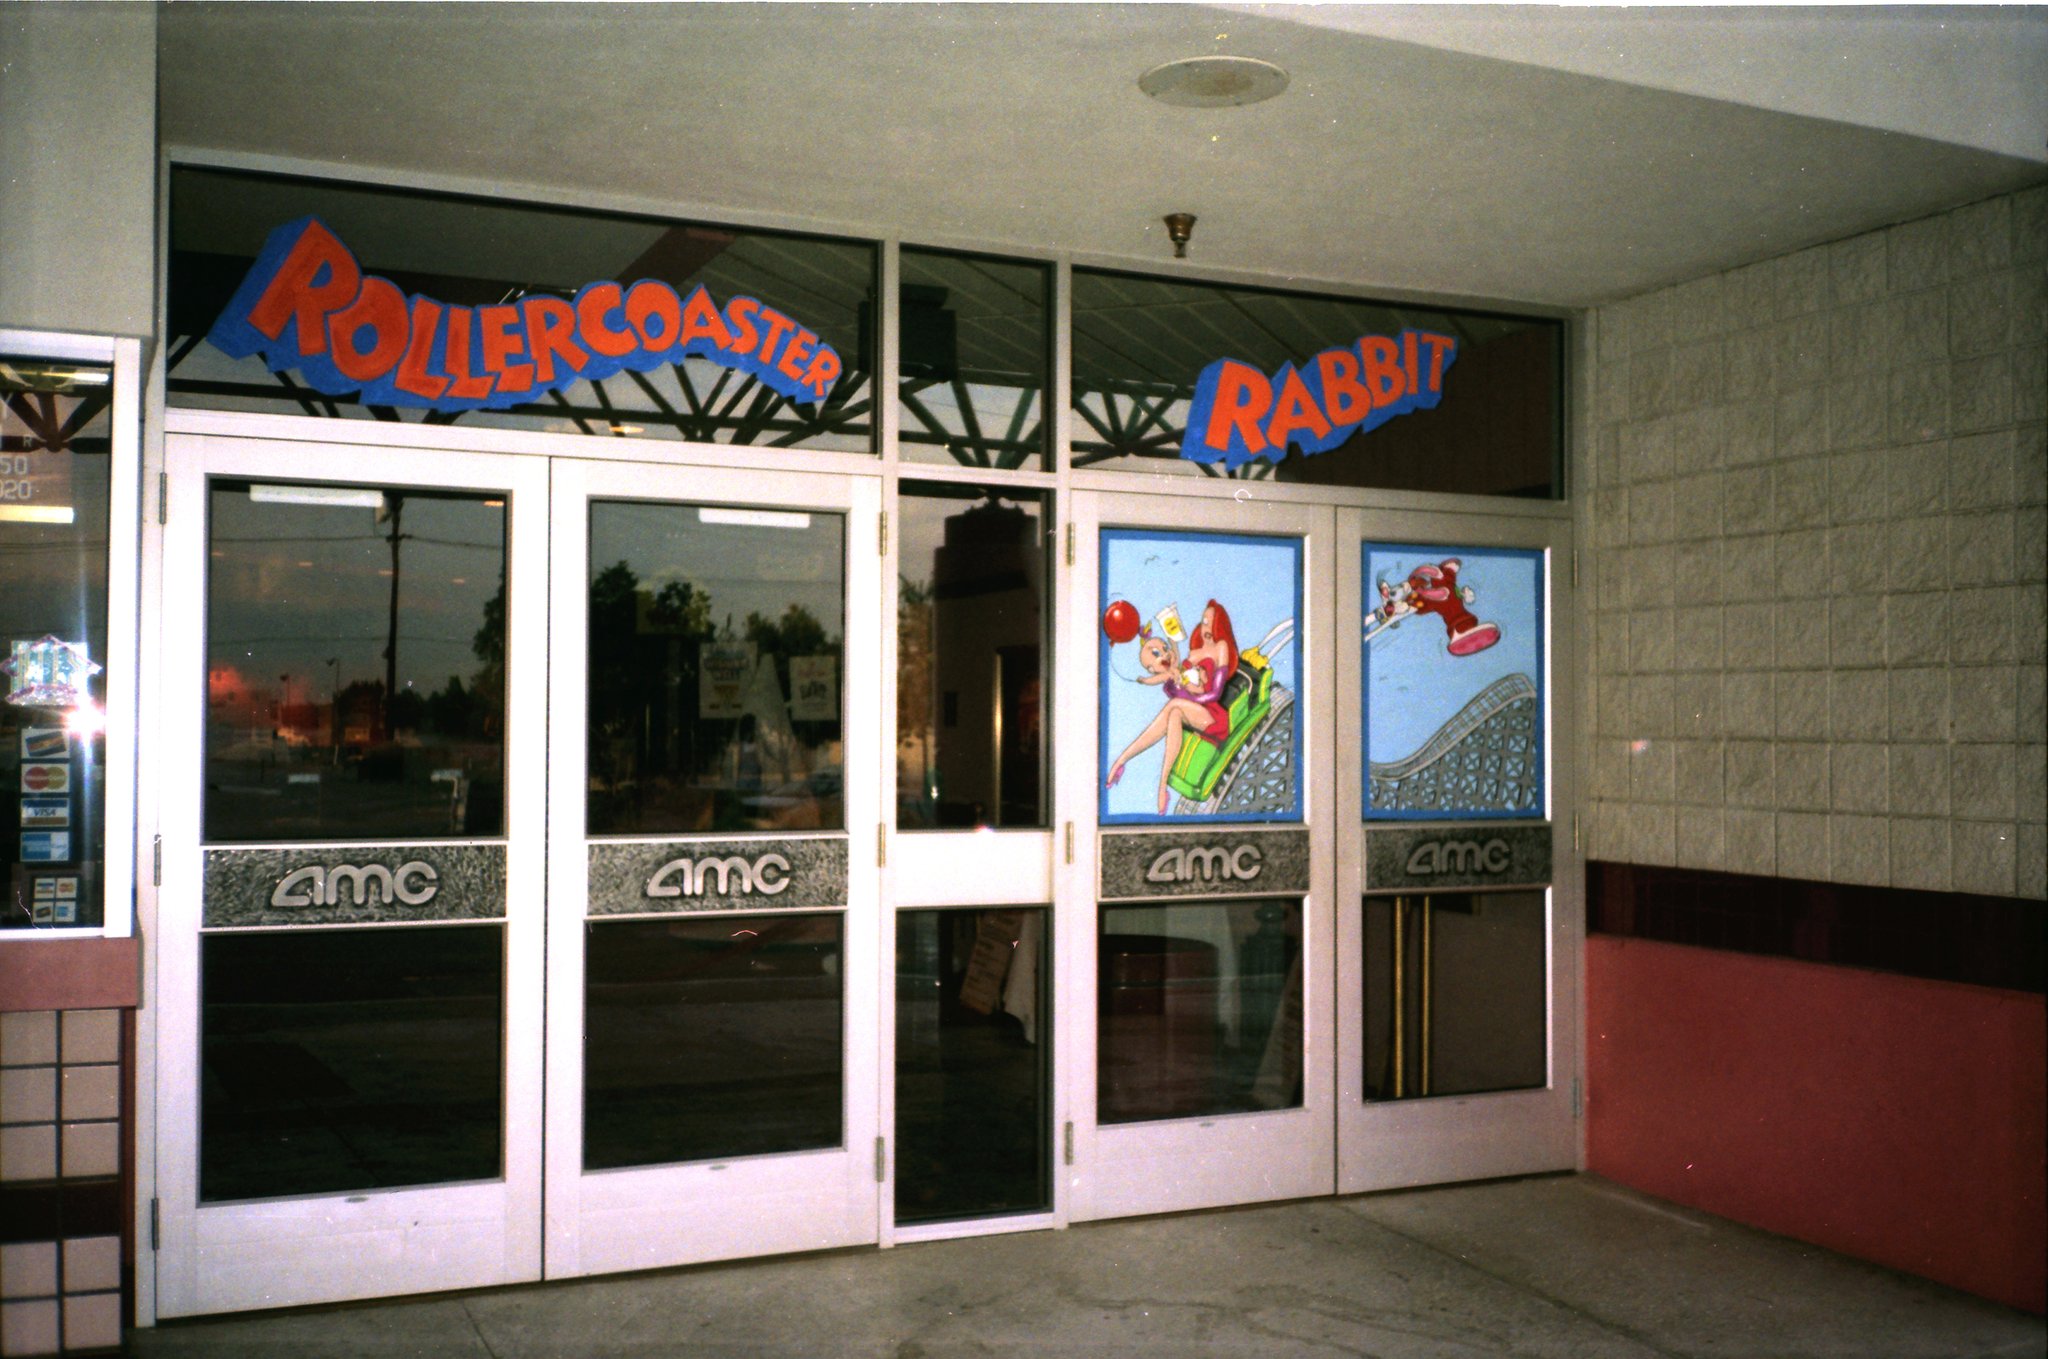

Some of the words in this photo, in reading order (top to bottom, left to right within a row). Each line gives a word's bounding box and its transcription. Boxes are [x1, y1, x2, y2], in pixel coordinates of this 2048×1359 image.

[246, 217, 841, 399] ROLLERCOASTER
[1204, 332, 1455, 455] RABBIT
[0, 480, 31, 499] 20
[34, 808, 57, 816] VISA
